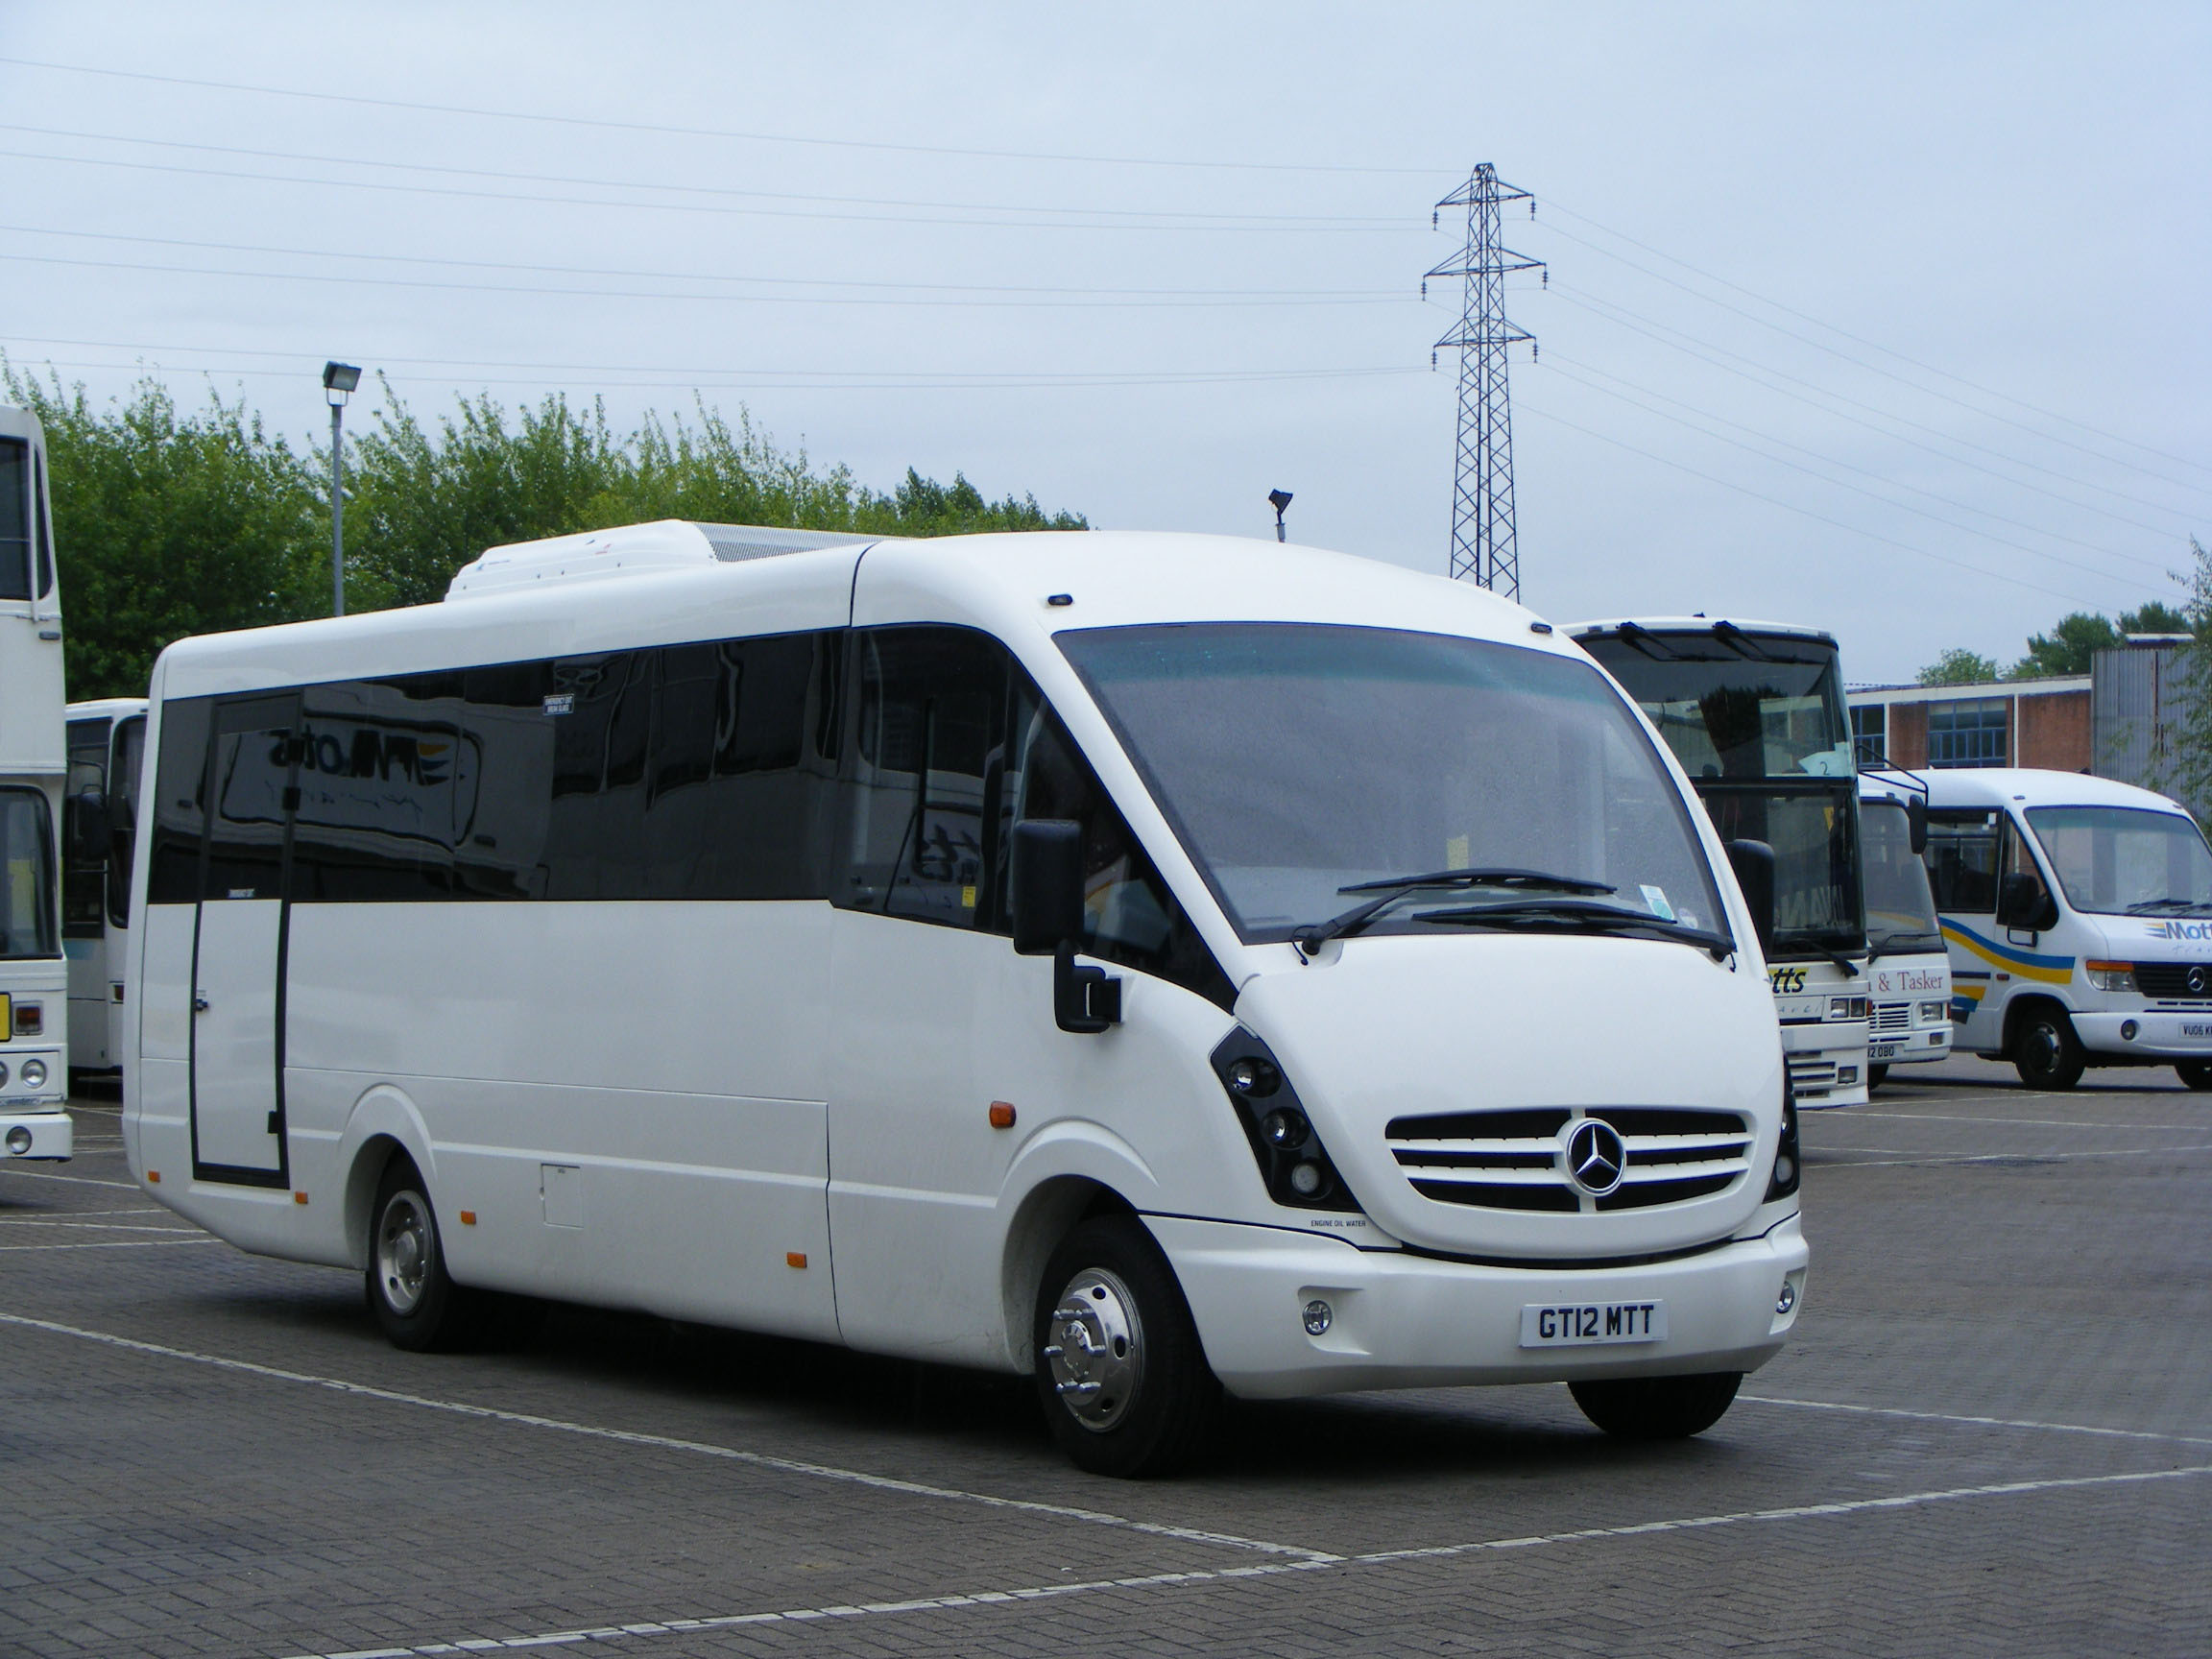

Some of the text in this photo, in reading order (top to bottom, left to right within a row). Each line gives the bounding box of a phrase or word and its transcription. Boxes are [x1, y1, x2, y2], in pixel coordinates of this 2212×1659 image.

[1820, 760, 1831, 776] 2
[1769, 968, 1807, 994] tts
[1878, 970, 1943, 992] & Tasker
[1539, 1304, 1654, 1338] GT12 MTT
